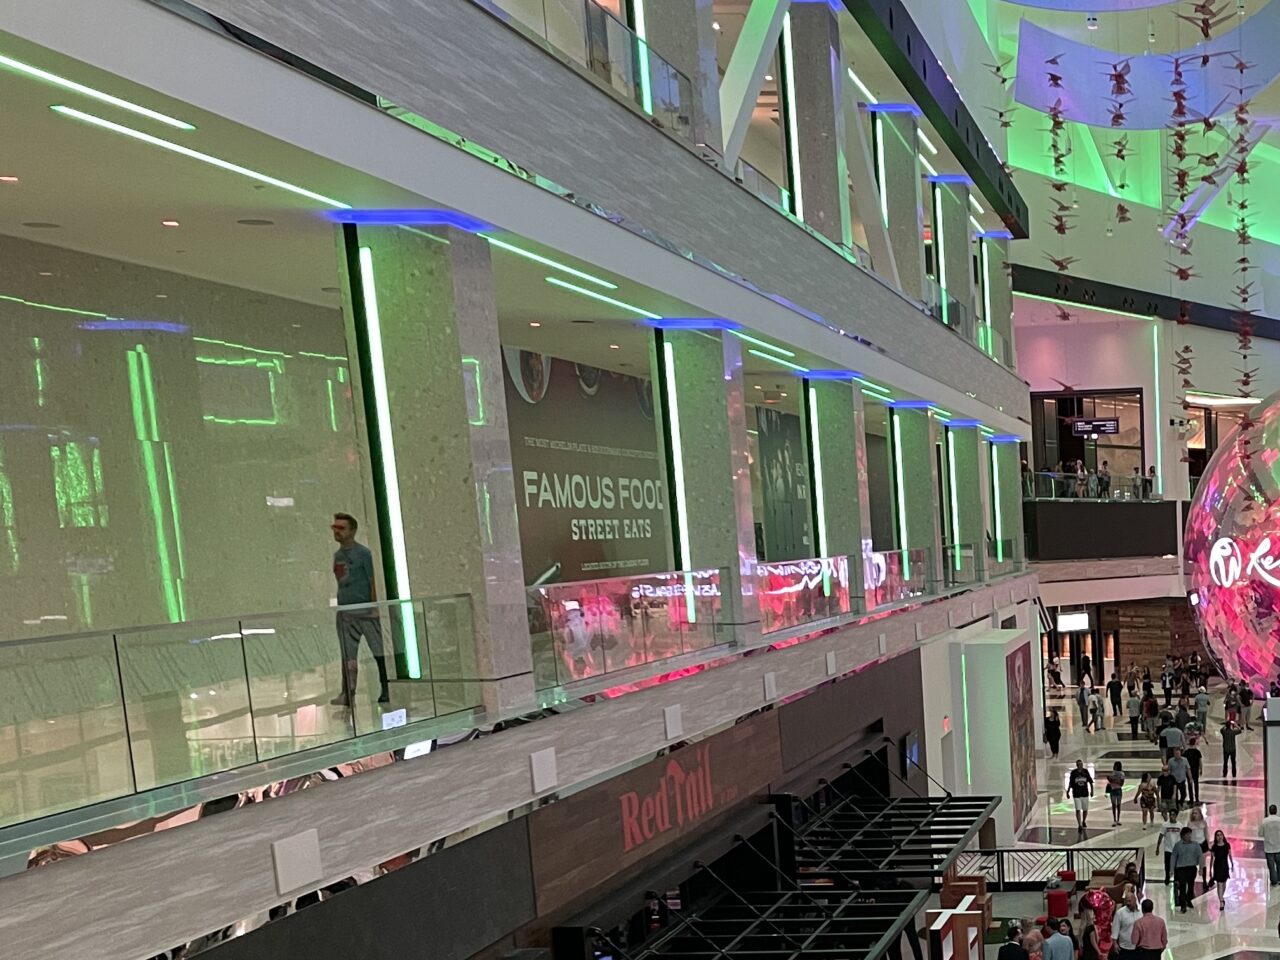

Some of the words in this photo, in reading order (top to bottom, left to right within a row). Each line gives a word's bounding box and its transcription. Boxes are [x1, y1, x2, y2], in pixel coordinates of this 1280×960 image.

[523, 470, 615, 510] FAMOUS
[571, 518, 620, 541] STREET
[624, 518, 652, 539] EATS
